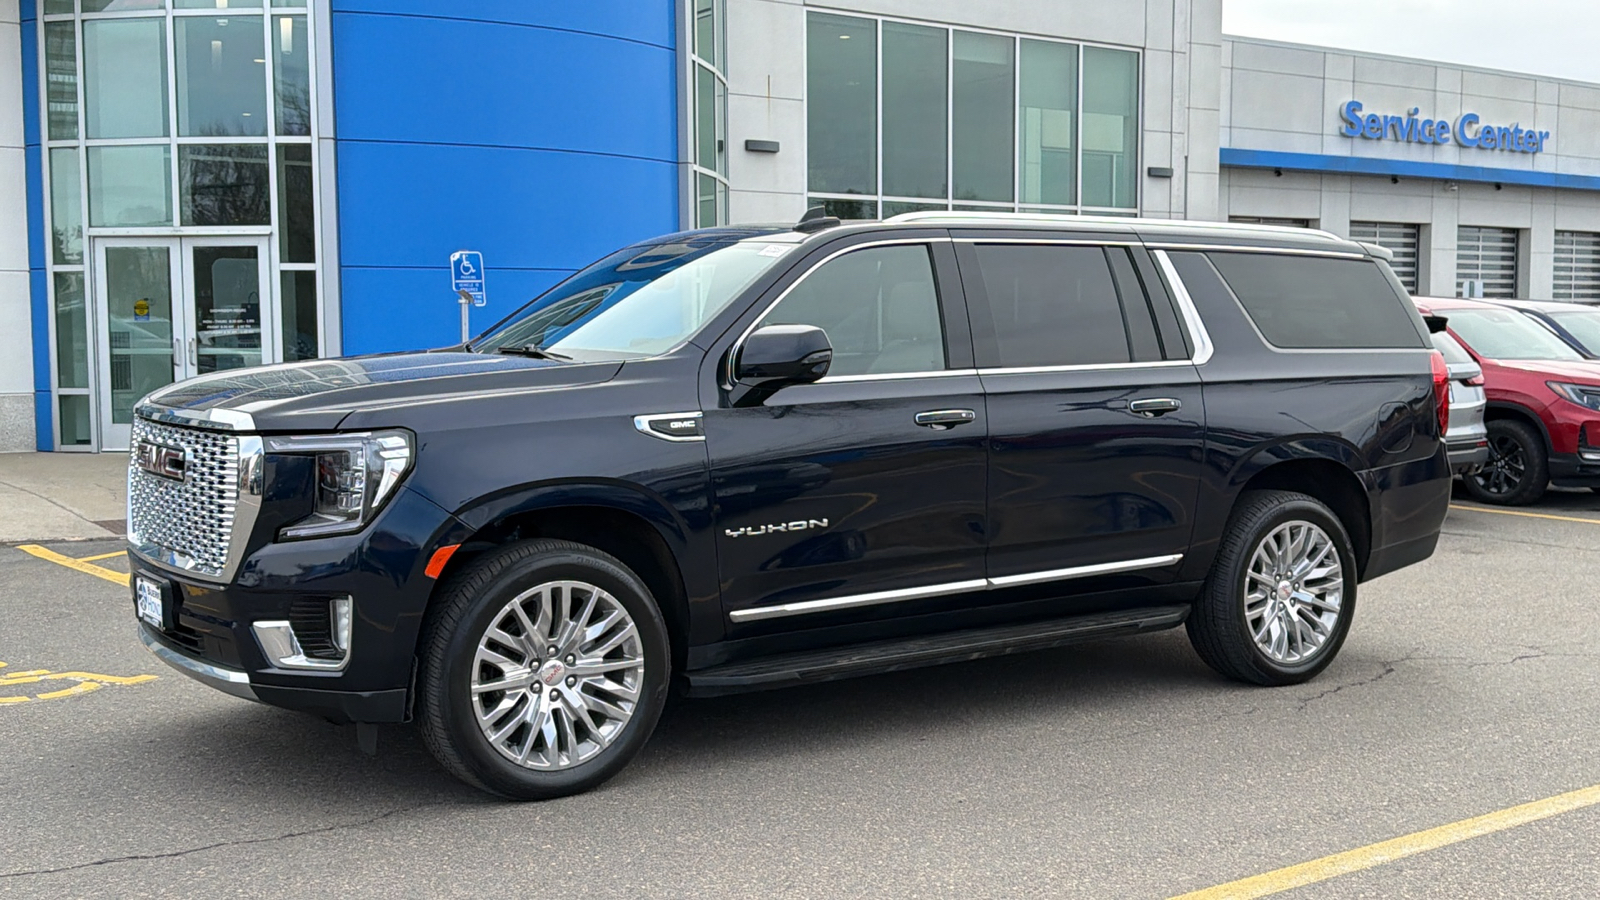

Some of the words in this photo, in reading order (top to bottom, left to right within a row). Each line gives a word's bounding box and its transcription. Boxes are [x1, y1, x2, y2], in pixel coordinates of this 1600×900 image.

[1342, 100, 1450, 144] Service
[1455, 112, 1549, 153] Center
[670, 420, 696, 429] GMC
[137, 442, 185, 480] GMC
[725, 518, 828, 537] YUKON
[545, 664, 563, 683] GMC
